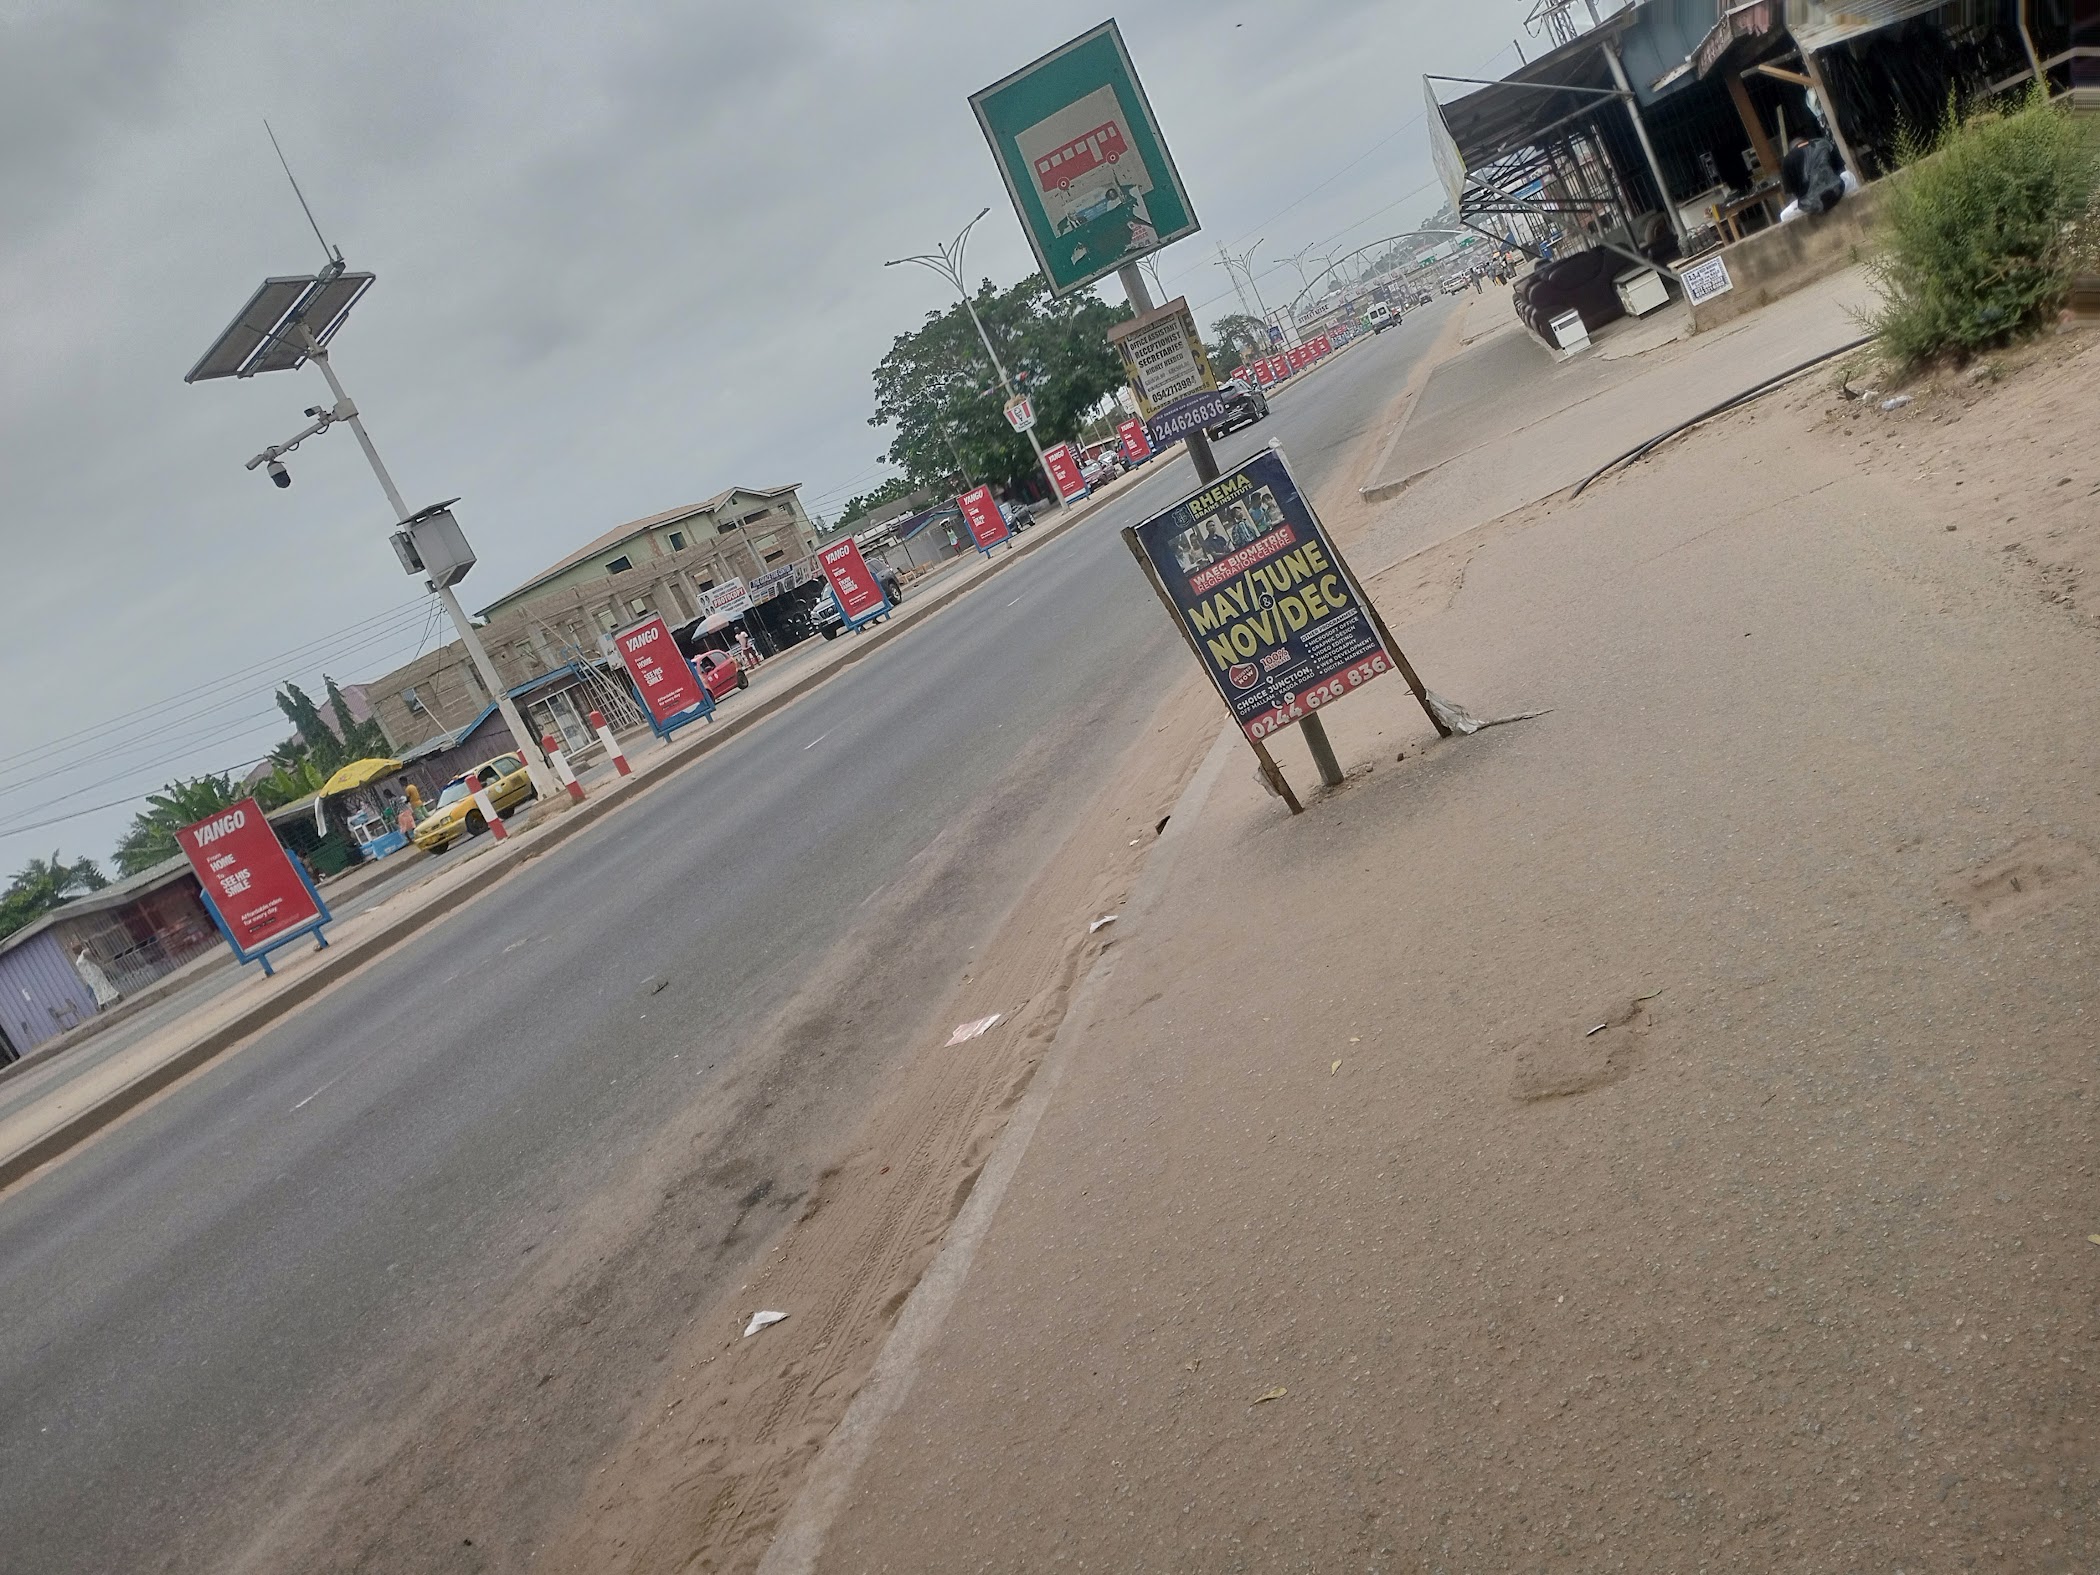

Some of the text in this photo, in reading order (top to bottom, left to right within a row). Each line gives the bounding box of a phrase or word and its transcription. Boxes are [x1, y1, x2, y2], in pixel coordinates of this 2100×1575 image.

[1129, 336, 1148, 350] OFFICE
[1147, 322, 1177, 341] ASSISTANT
[1134, 330, 1181, 359] RECEPTIONIST
[1138, 340, 1183, 368] SECRETARIES
[962, 489, 984, 505] YANGO
[1187, 471, 1250, 514] RHEMA
[1218, 482, 1253, 505] INSTITUTE
[825, 545, 850, 565] YANGO
[1192, 528, 1288, 586] WAEC BIOMETRIC
[1197, 536, 1291, 593] REGISTRATION CENTRE
[713, 587, 744, 607] PHOTOCOPY
[1187, 539, 1329, 637] MAY/JUNE
[1206, 573, 1348, 670] NOV/DEC
[1308, 616, 1358, 646] MICROSOFT OFFICE
[625, 628, 660, 652] YANGO
[1311, 624, 1355, 651] GRAPHIC DESIGN
[1314, 633, 1353, 657] VIDEO EDITING
[1259, 646, 1288, 667] 100%
[1317, 638, 1357, 662] PHOTOGRAPHY
[1320, 636, 1372, 668] WEB DEVELOPMENT
[1323, 642, 1375, 673] DIGITAL MARKETING
[636, 656, 654, 669] HOME
[1235, 664, 1313, 710] CHOICE JUNCTION,
[1237, 669, 1254, 684] NOW
[1239, 706, 1252, 716] OFF
[1251, 693, 1275, 709] MALLAM
[1278, 680, 1298, 694] KASOA
[1297, 671, 1315, 683] ROAD
[1251, 655, 1387, 739] 0244 626 836
[193, 809, 247, 847] YANGO
[205, 851, 222, 863] From
[209, 853, 236, 872] HOME
[216, 872, 225, 880] To
[219, 867, 251, 889] SEE HIS
[224, 878, 251, 898] SMILE
[240, 902, 269, 921] Affordable
[243, 918, 252, 926] for
[251, 910, 268, 922] every
[265, 905, 278, 915] day
